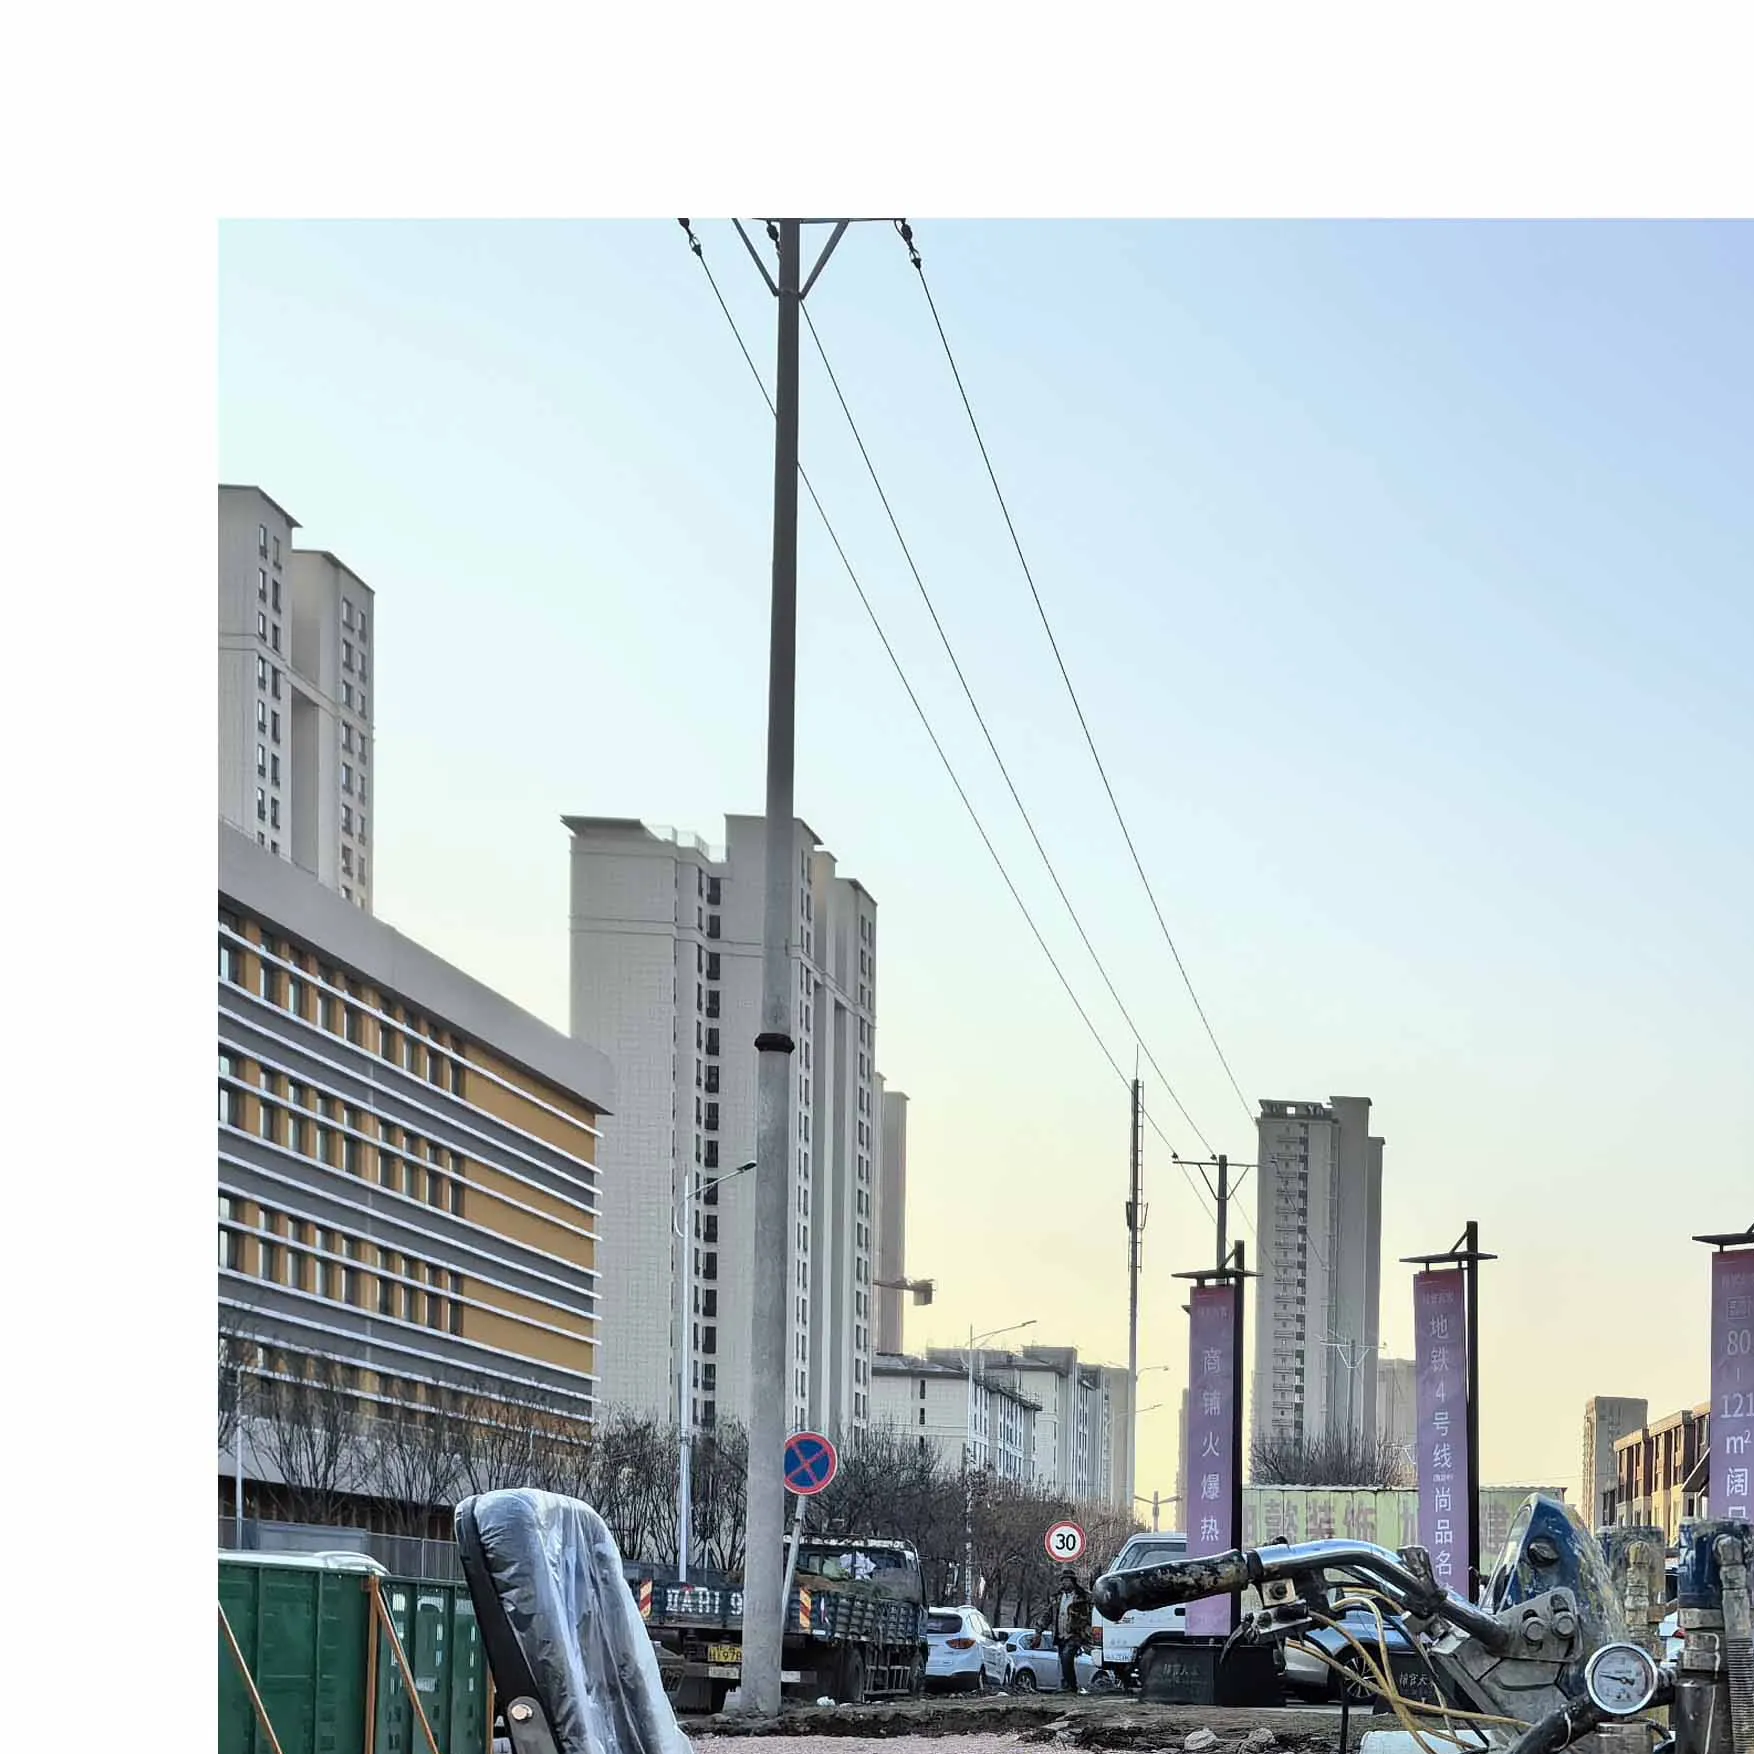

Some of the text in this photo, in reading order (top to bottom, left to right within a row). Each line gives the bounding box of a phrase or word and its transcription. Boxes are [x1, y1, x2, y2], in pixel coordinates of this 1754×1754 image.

[1055, 1533, 1077, 1551] 30
[1434, 1486, 1454, 1591] 尚品名
